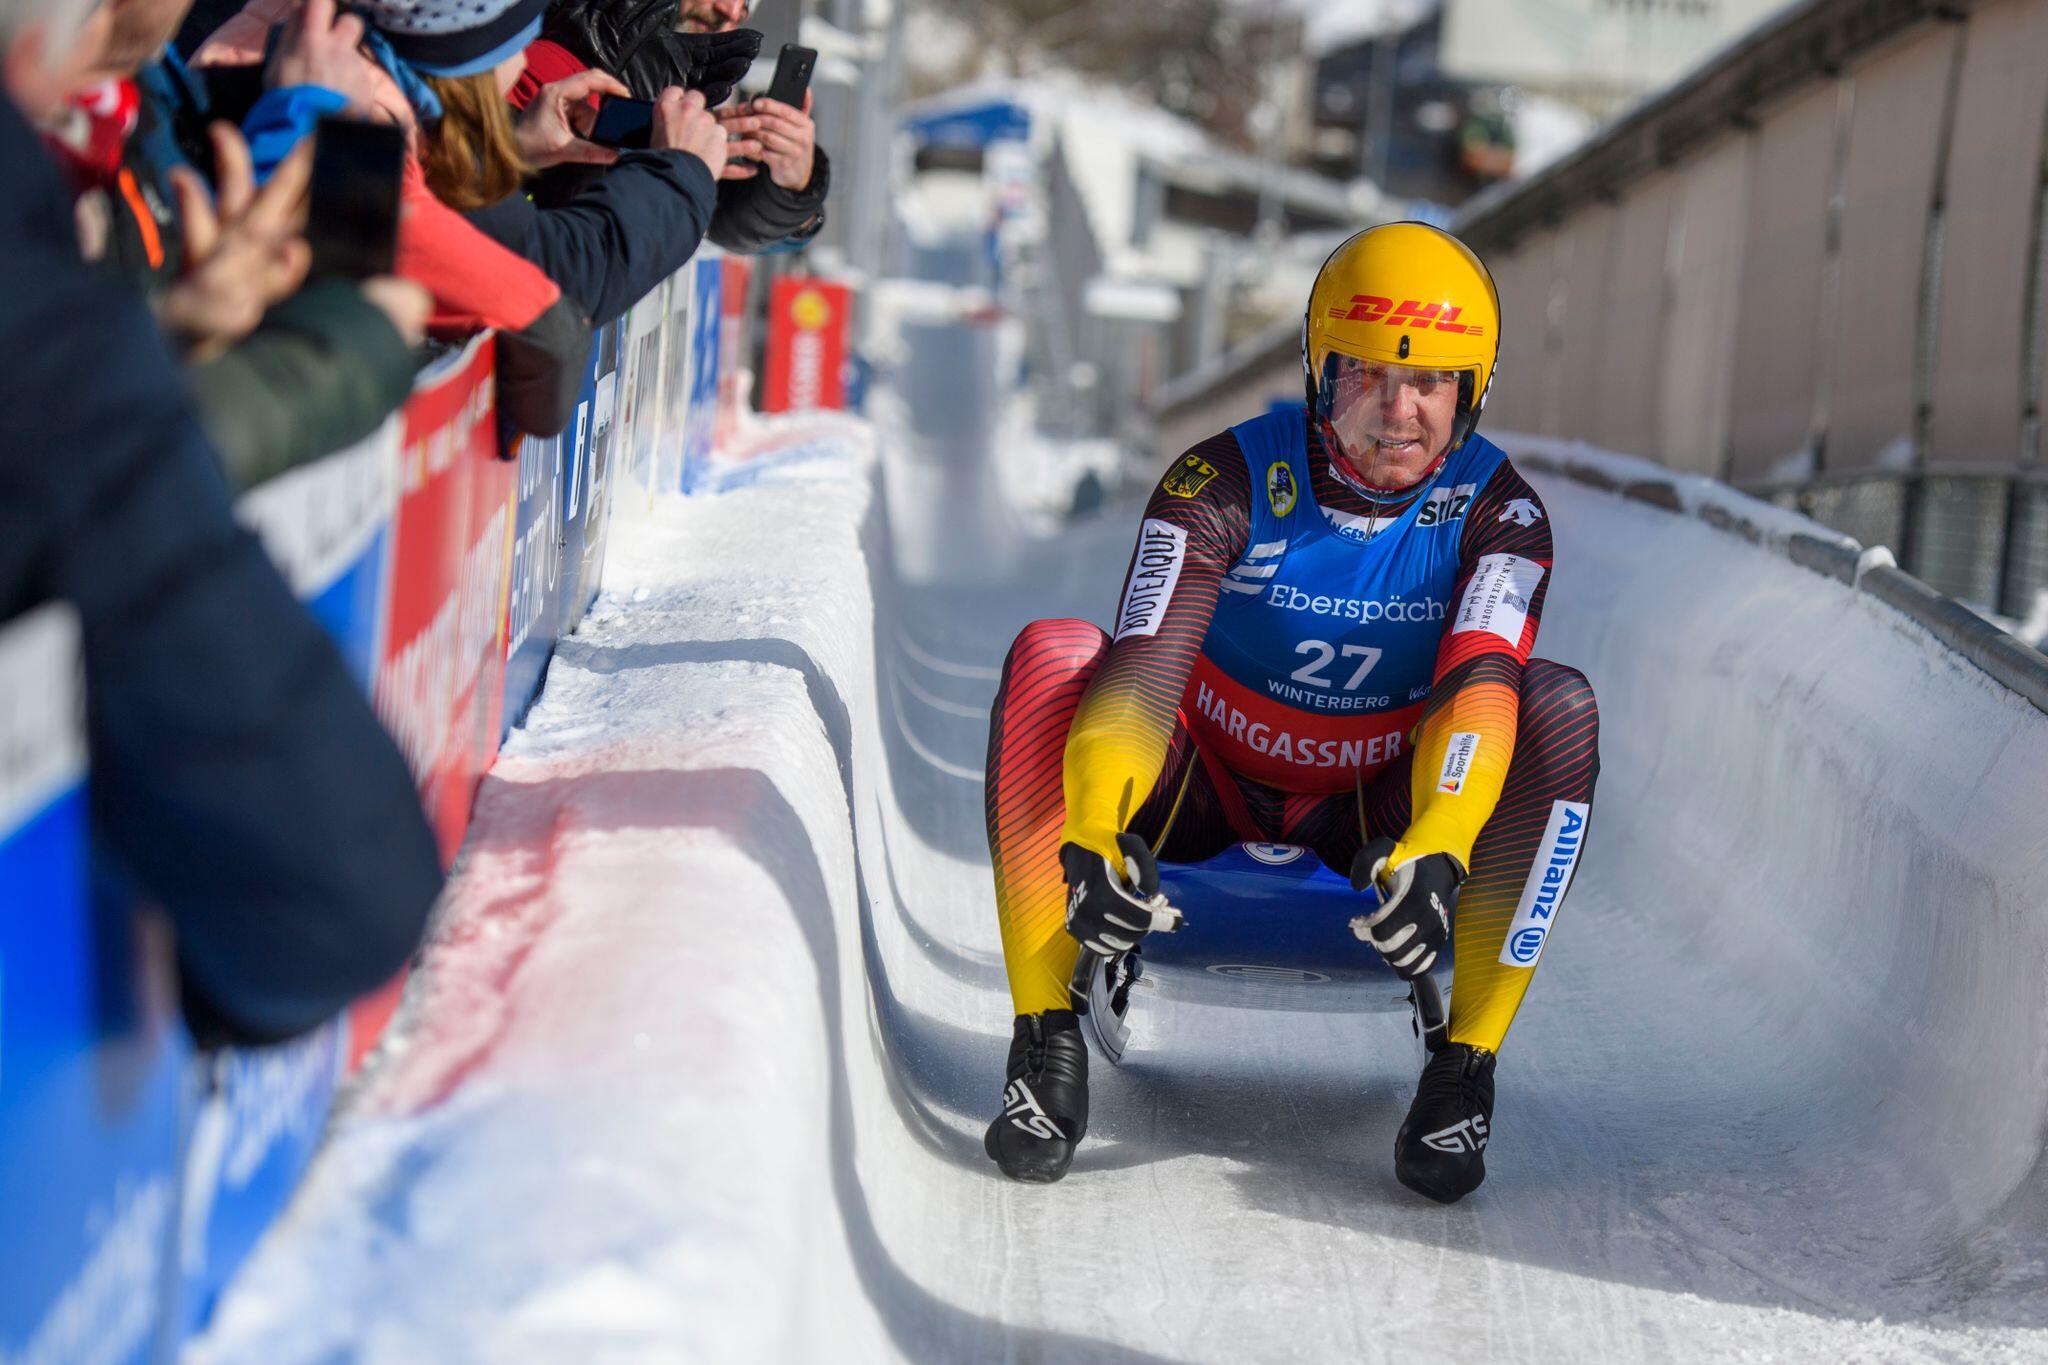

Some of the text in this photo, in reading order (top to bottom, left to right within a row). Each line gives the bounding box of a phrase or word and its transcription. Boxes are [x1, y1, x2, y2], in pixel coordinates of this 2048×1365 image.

[1343, 294, 1469, 334] DHL
[1266, 584, 1451, 625] Eberspäch
[1479, 594, 1498, 630] RESORTS
[1291, 639, 1383, 691] 27
[1267, 679, 1391, 710] WINTERBERG
[1196, 680, 1402, 768] HARGASSNER
[1451, 734, 1475, 779] Sporthilfe
[1530, 807, 1584, 920] Allianz
[1420, 1113, 1488, 1154] GTS
